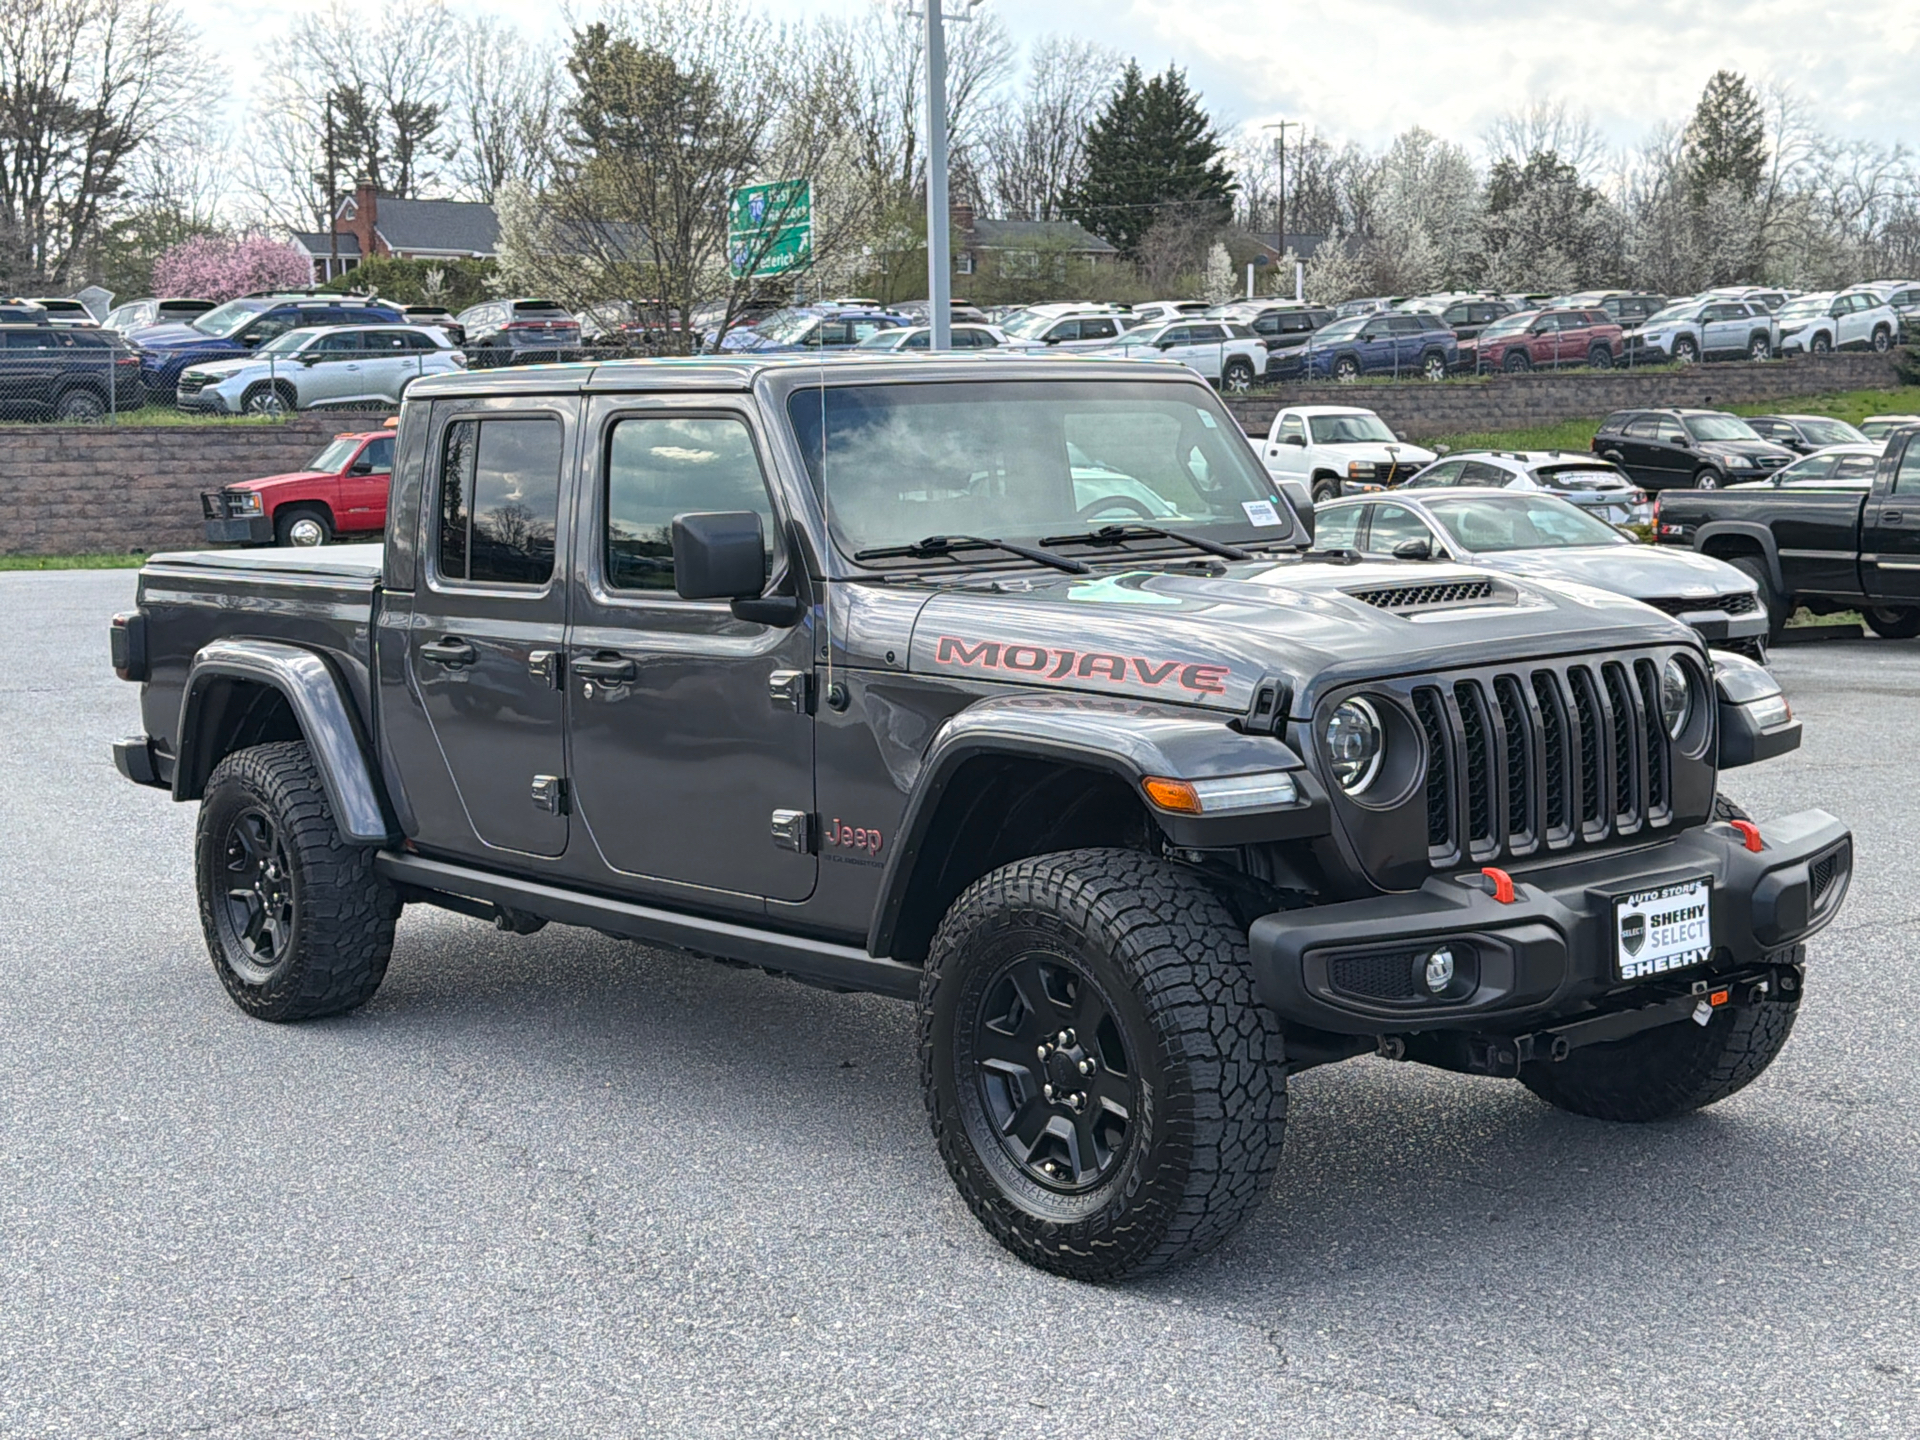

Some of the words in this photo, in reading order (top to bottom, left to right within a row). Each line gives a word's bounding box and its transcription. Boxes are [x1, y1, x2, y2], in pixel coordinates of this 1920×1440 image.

[1661, 524, 1683, 535] Z71
[936, 636, 1230, 694] MOJAVE
[825, 818, 883, 857] Jeep
[1627, 891, 1658, 904] AUTO
[1661, 881, 1702, 898] STORES
[1650, 903, 1706, 928] SHEEHY
[1622, 927, 1644, 938] SELECT
[1651, 920, 1706, 948] SELECT
[1621, 946, 1712, 979] SHEEHY
